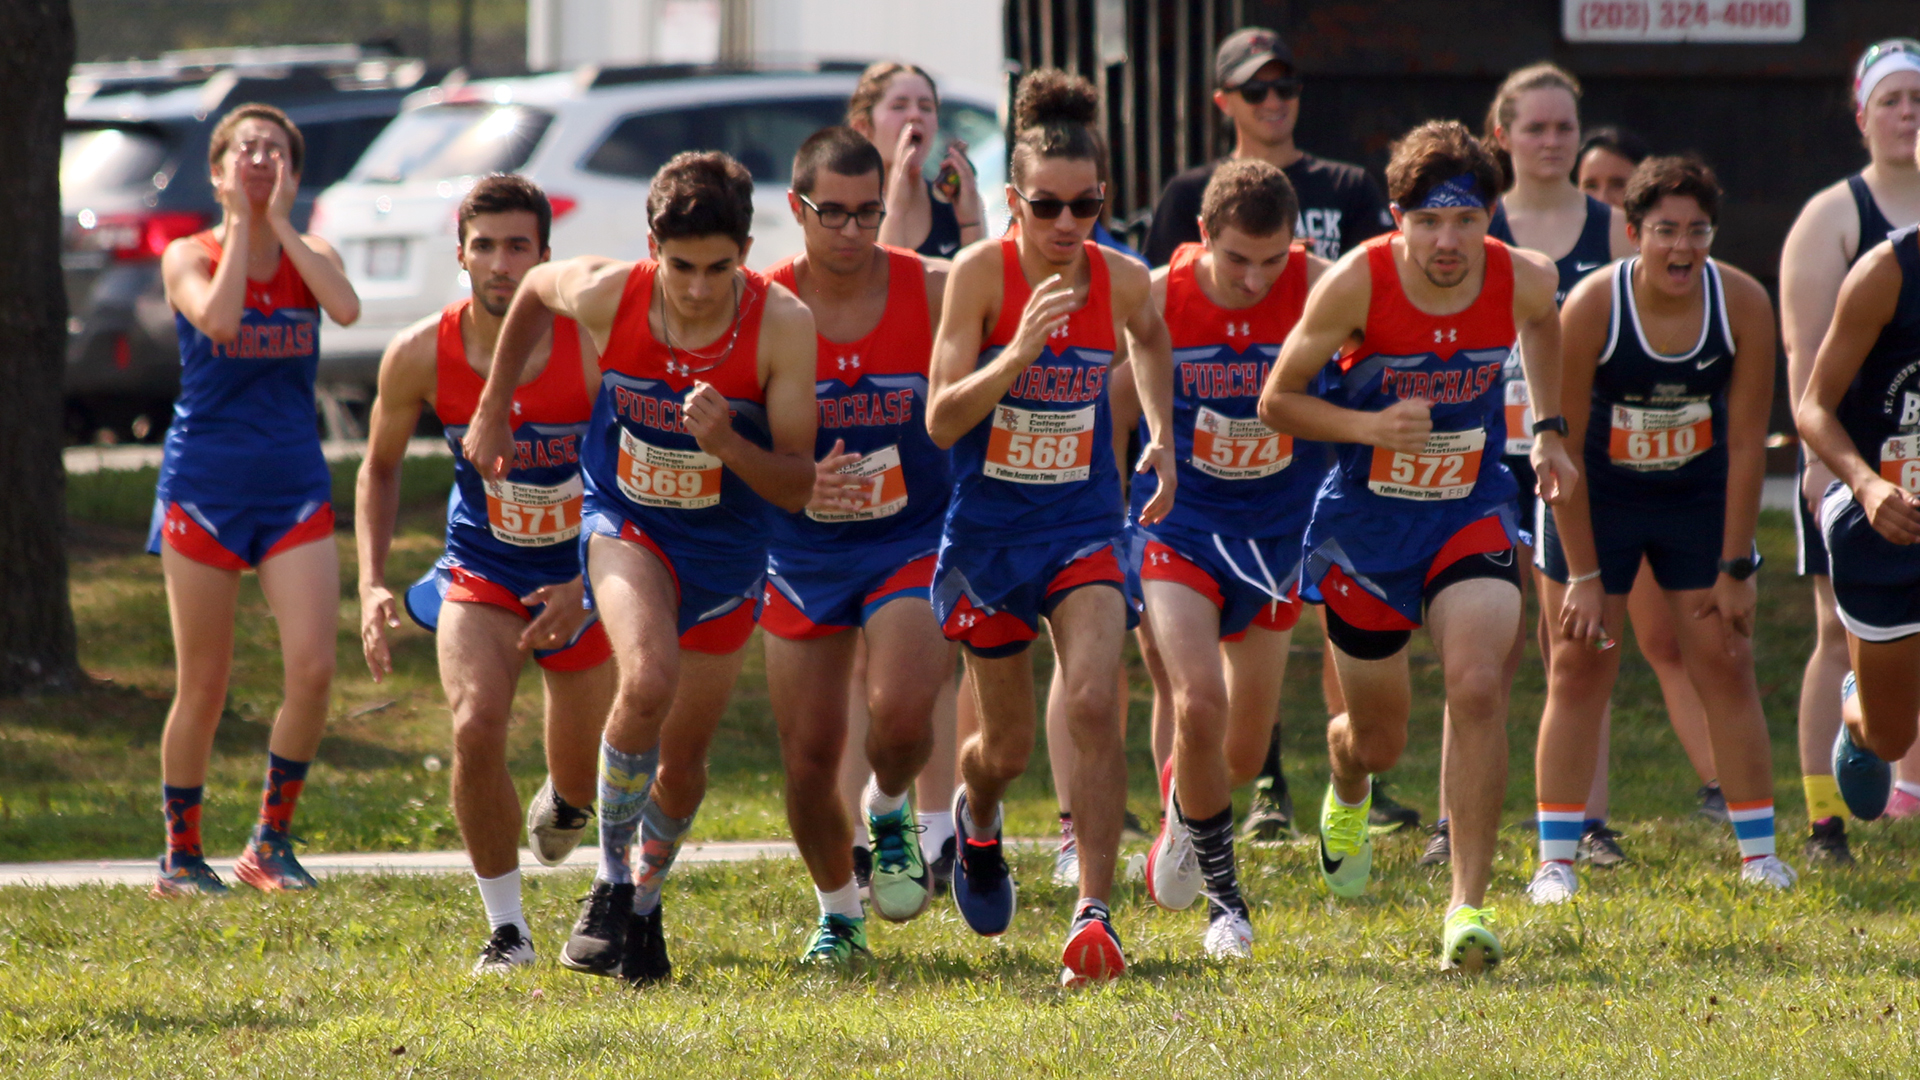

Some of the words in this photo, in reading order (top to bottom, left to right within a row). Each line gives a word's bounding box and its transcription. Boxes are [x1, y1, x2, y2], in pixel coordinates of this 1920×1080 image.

[1579, 1, 1649, 36] (203)
[1294, 209, 1342, 238] ACK
[1009, 365, 1108, 402] URCHASE
[1181, 362, 1271, 398] PURCHA
[616, 384, 697, 436] PURCH
[1029, 420, 1067, 428] College
[1029, 425, 1085, 433] Invitational
[1628, 427, 1696, 460] 610
[1007, 434, 1079, 469] 568
[1211, 436, 1280, 467] 574
[630, 459, 703, 498] 569
[1391, 452, 1465, 486] 572
[501, 502, 566, 534] 571
